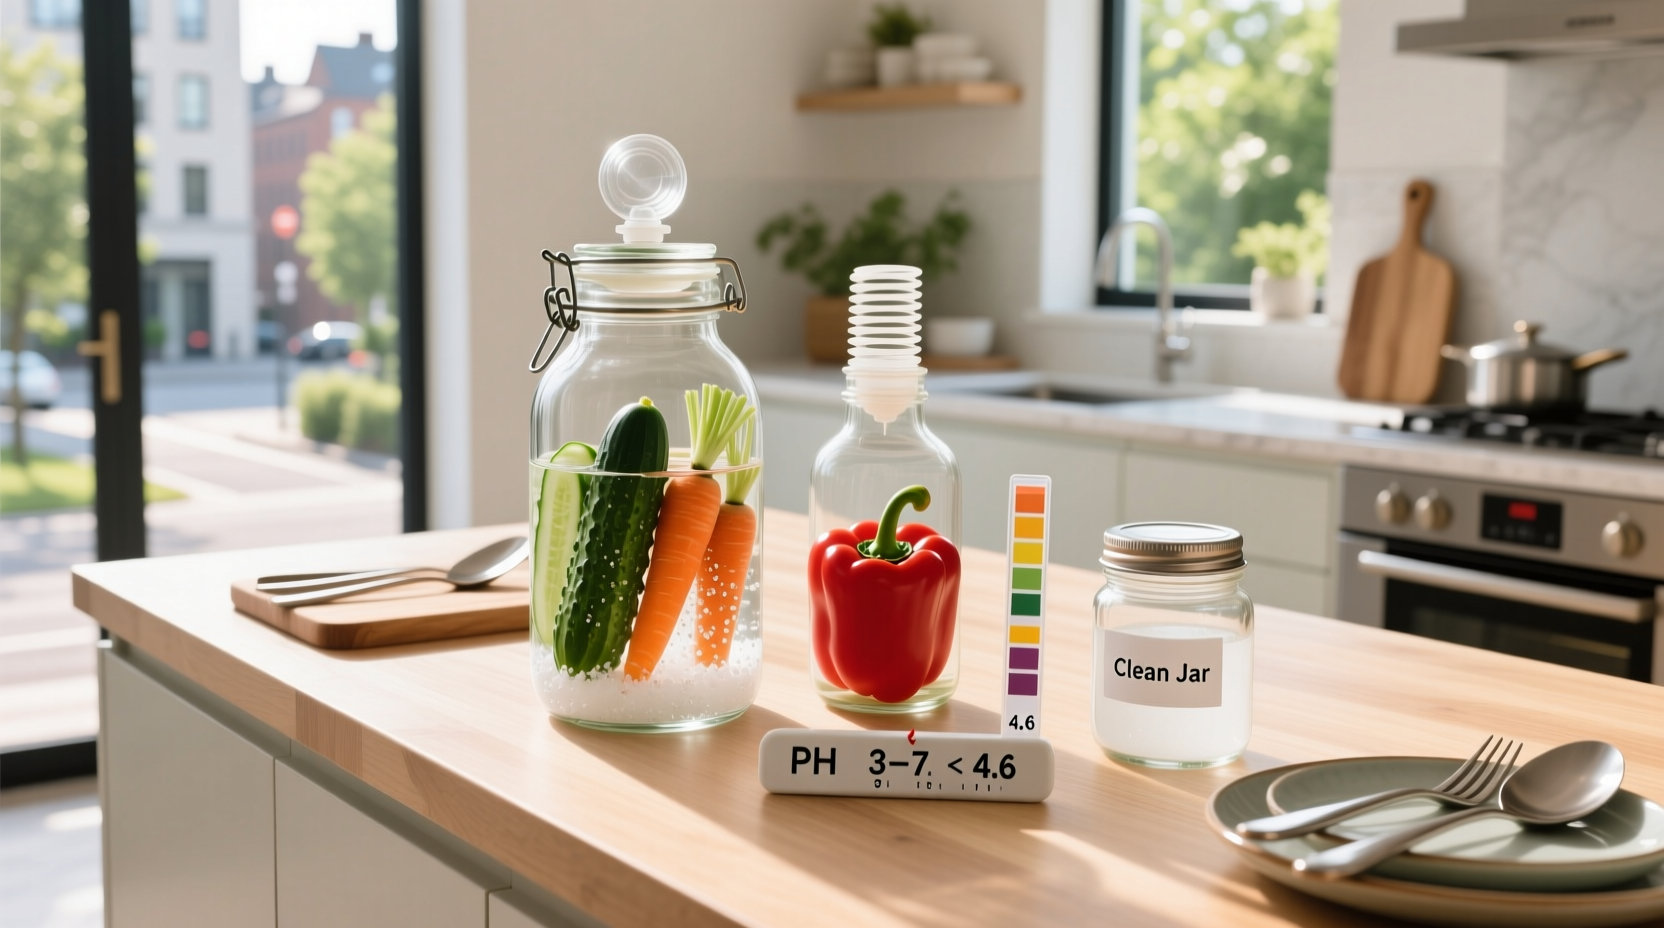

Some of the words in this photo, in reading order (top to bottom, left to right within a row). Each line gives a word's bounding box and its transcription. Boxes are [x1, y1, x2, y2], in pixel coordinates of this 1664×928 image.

[1114, 657, 1169, 682] Clean
[1176, 663, 1211, 683] Jar
[1008, 714, 1035, 731] 4.6
[791, 745, 837, 775] PH
[972, 752, 1017, 780] 4.6
